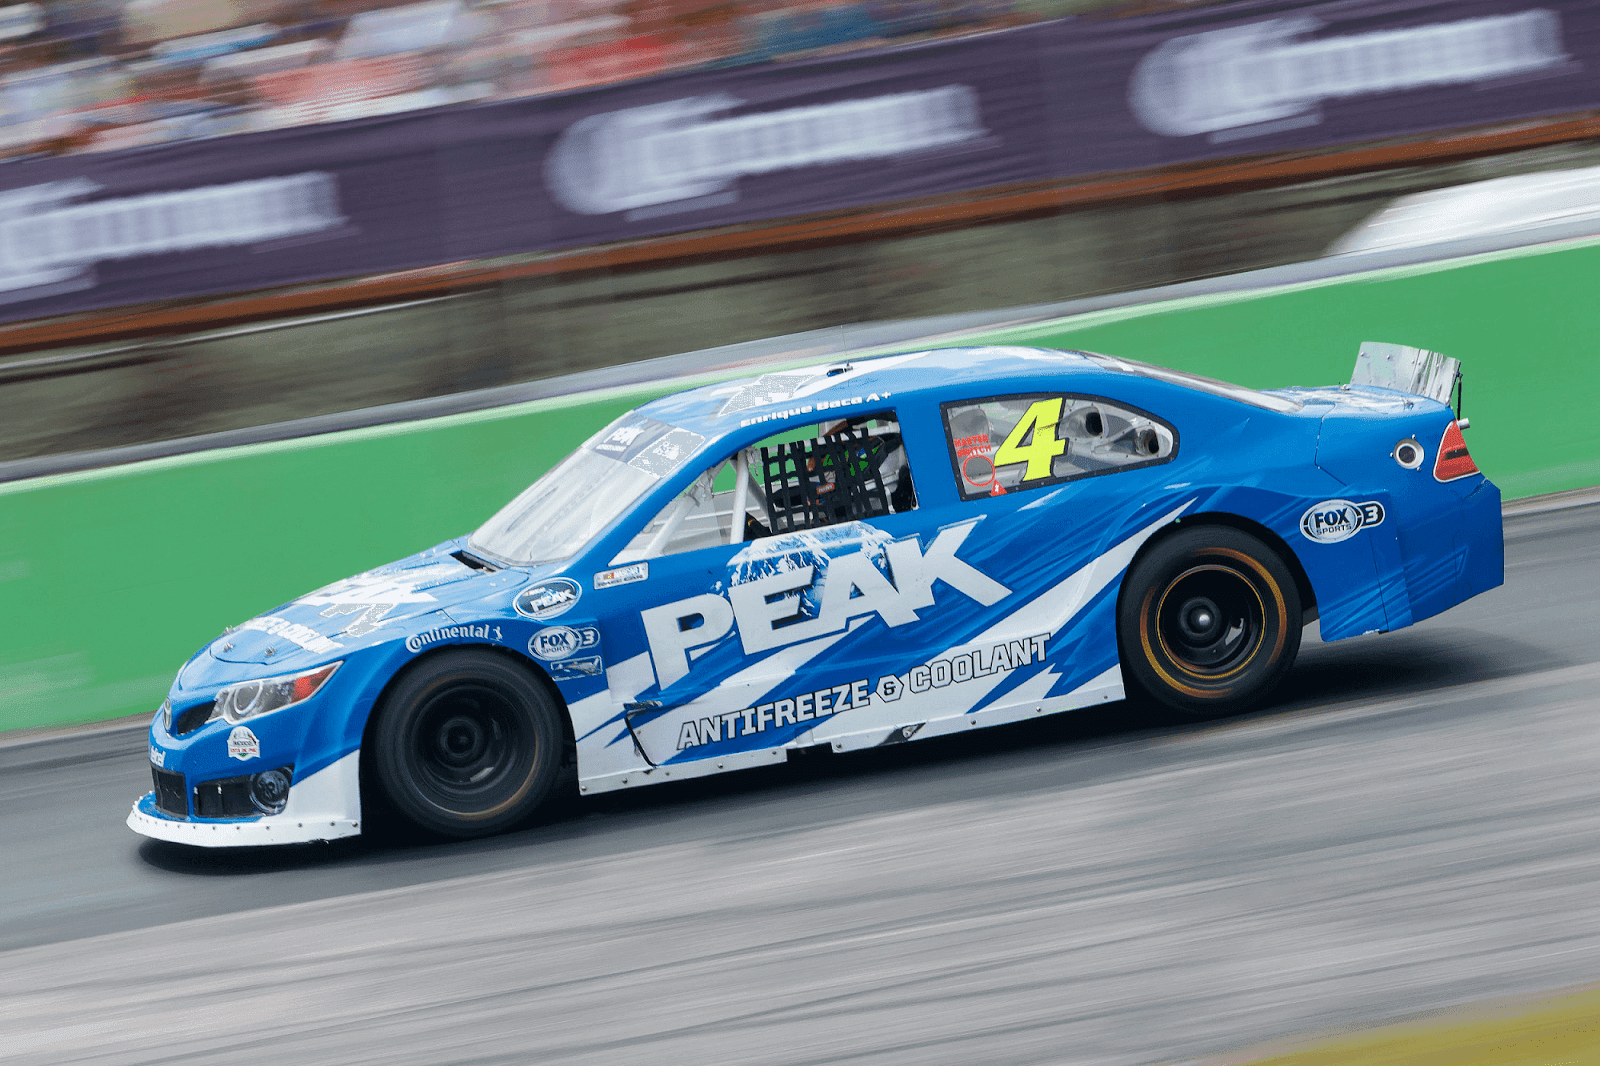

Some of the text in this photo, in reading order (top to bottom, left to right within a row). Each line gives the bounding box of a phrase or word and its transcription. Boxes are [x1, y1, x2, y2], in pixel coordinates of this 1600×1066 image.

[740, 391, 892, 428] Enrique Baca A+
[953, 434, 989, 448] MASTER
[993, 397, 1067, 482] 4
[1314, 507, 1350, 528] FOX
[1365, 505, 1379, 523] 3
[1316, 524, 1352, 536] SPORTS
[530, 588, 578, 613] PEAK
[640, 515, 1013, 691] PEAK
[405, 623, 490, 653] Continental
[540, 632, 570, 648] FOX
[583, 630, 595, 645] 3
[541, 644, 572, 654] SPORTS
[677, 679, 869, 751] ANTIFREEZE
[908, 632, 1052, 694] COOLANT
